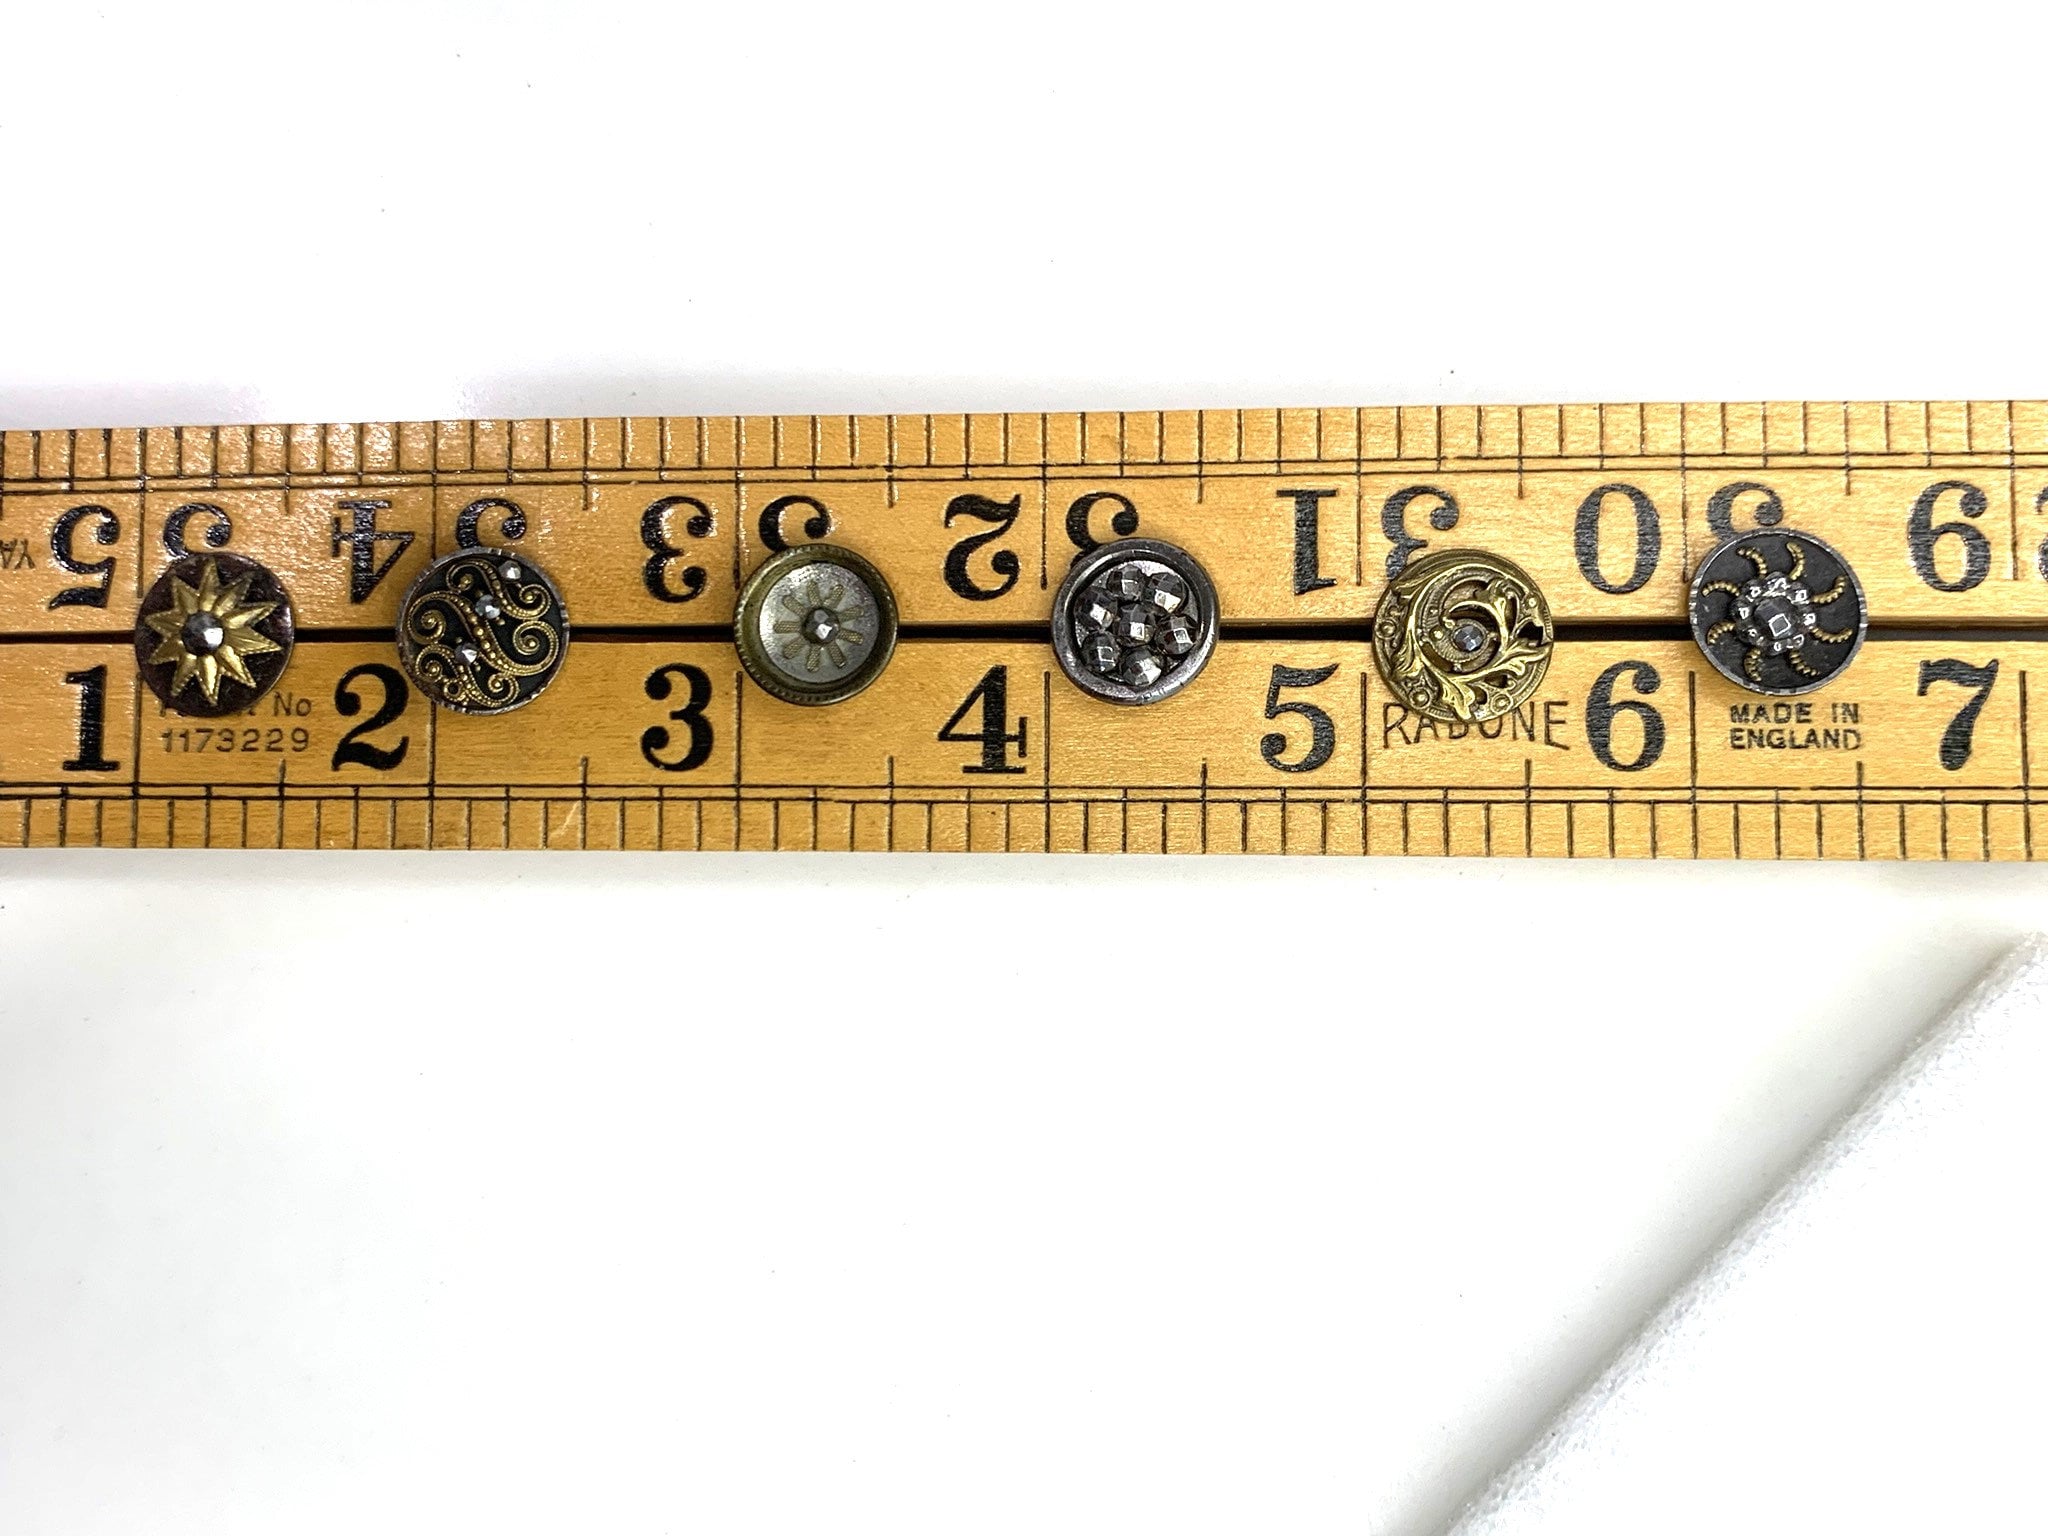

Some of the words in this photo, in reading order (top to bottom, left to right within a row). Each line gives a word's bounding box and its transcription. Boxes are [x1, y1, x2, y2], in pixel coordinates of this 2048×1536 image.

[61, 662, 121, 773] 1
[162, 727, 310, 753] 1173229
[273, 691, 311, 718] No
[331, 663, 409, 772] 2
[640, 663, 715, 773] 3
[938, 664, 1028, 775] 4
[1260, 663, 1340, 773] 5
[1586, 660, 1666, 772] 6
[1729, 702, 1813, 724] MADE
[1830, 702, 1860, 724] IN
[1729, 727, 1862, 751] ENGLAND
[1917, 658, 2000, 771] 7
